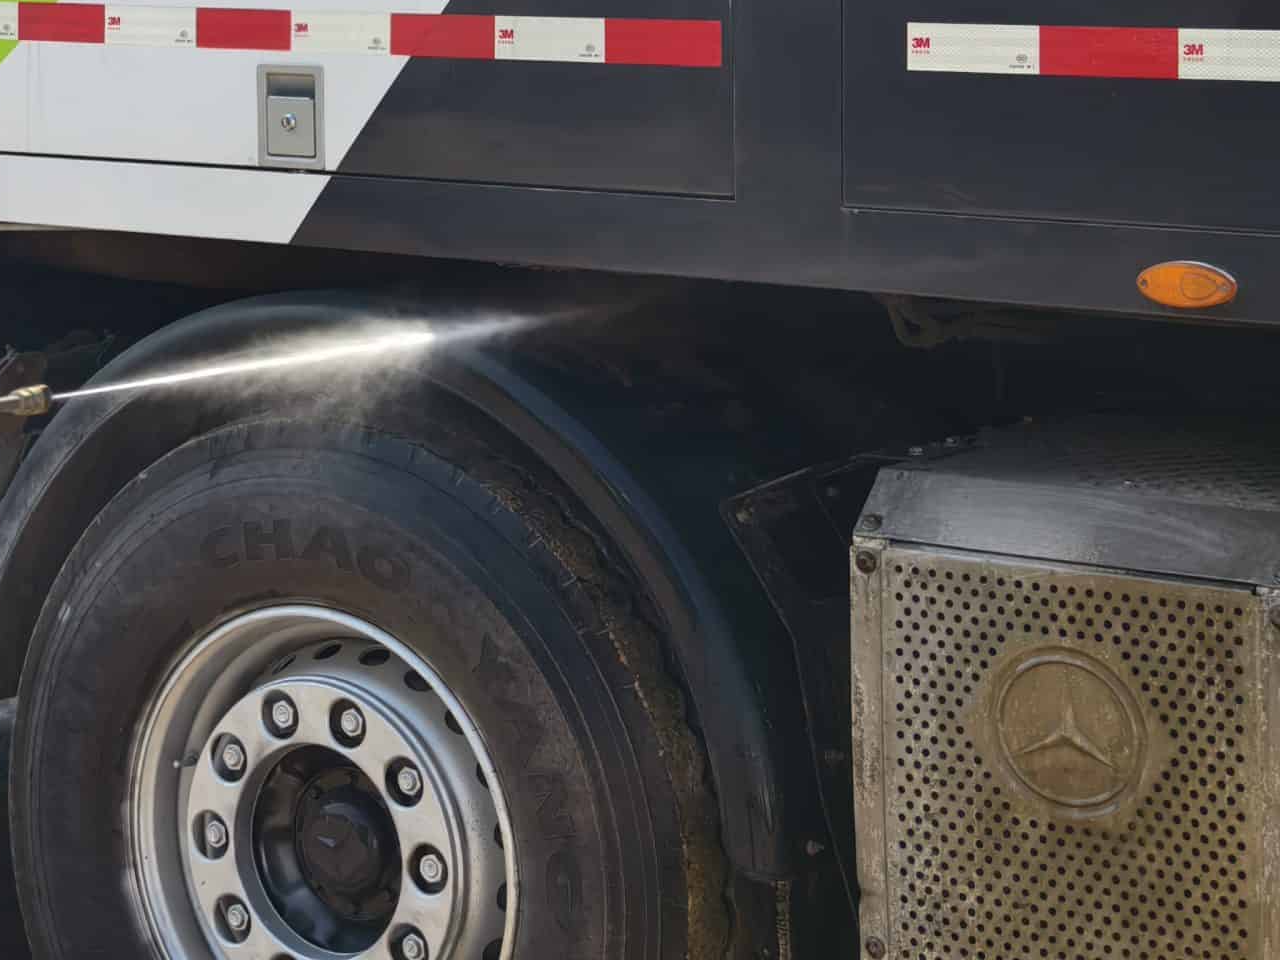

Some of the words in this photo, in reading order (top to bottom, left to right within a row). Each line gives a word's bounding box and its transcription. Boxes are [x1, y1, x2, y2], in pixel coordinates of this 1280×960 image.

[107, 16, 121, 26] 3M
[294, 23, 309, 33] 3M
[498, 29, 514, 40] 3M
[911, 37, 930, 49] 3M
[1183, 43, 1203, 56] 3M
